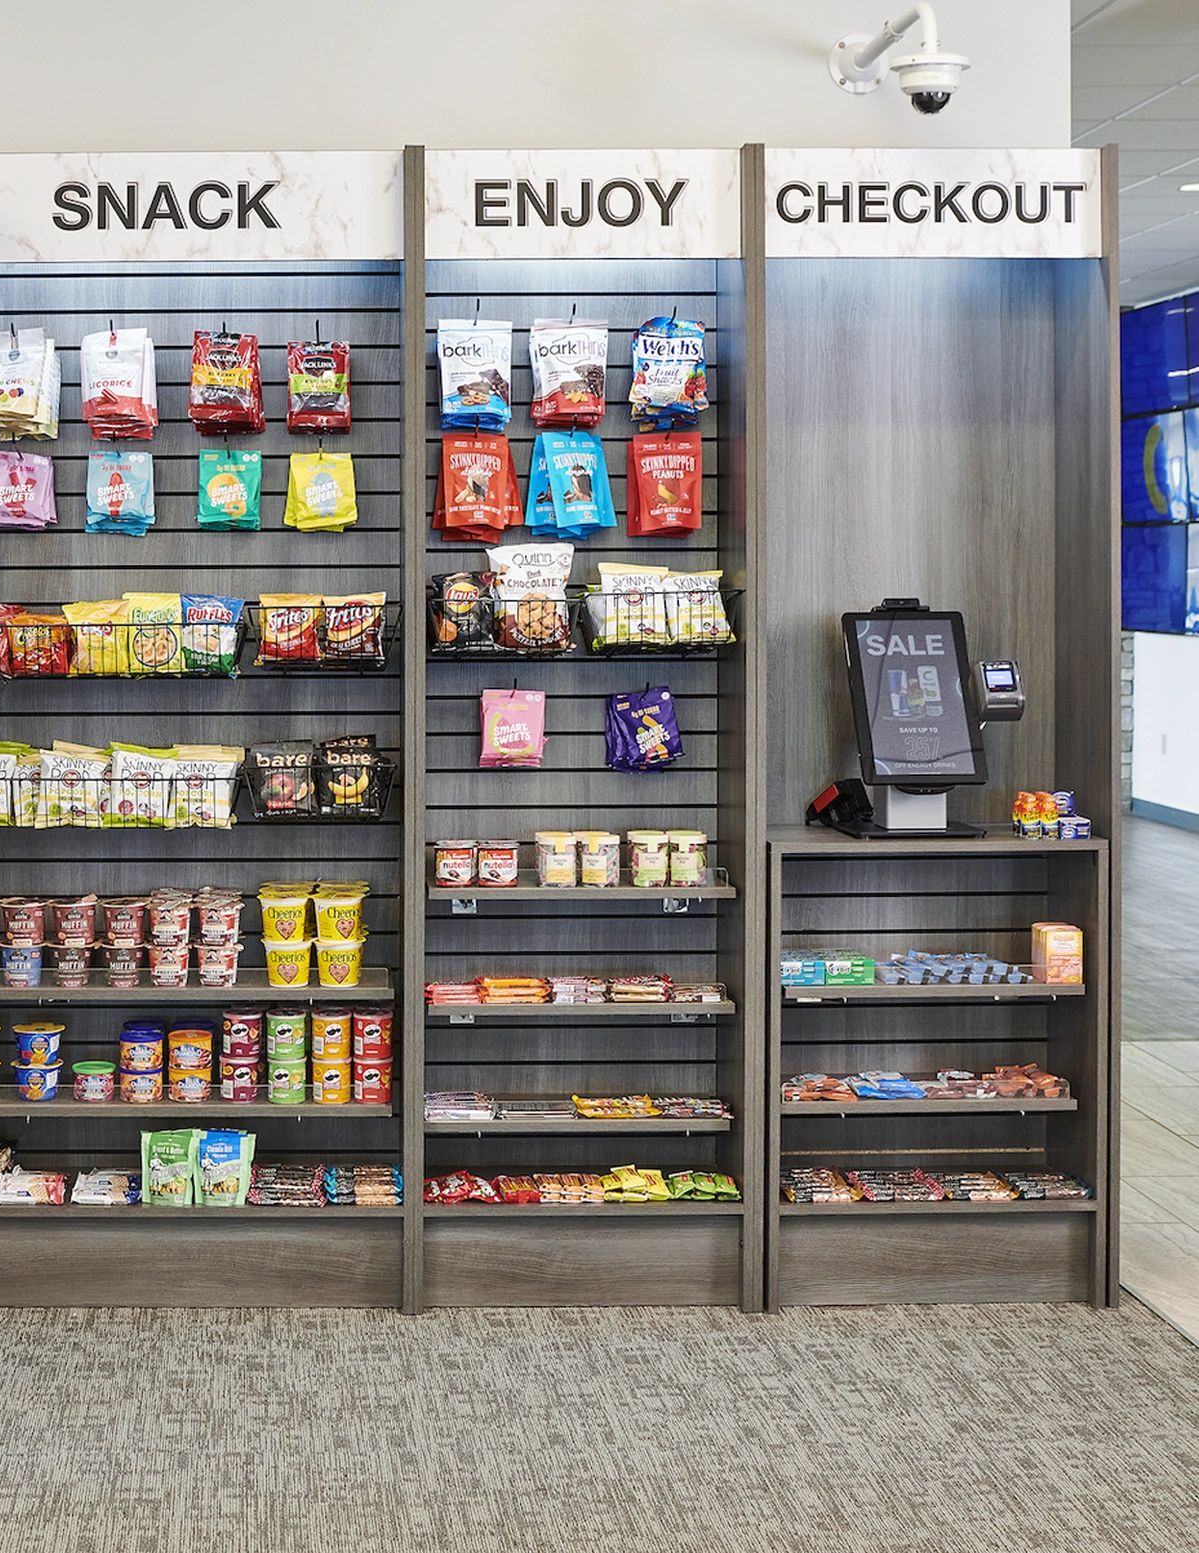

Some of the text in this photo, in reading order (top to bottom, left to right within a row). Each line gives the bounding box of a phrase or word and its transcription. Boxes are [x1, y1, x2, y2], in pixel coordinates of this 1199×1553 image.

[52, 180, 280, 230] SNACK
[475, 177, 688, 228] ENJOY
[776, 182, 1087, 223] CHECKOUT
[641, 337, 700, 357] Welch's
[89, 379, 133, 390] LICORICE
[652, 470, 684, 480] PEANUTS
[97, 483, 132, 496] SMART
[211, 484, 246, 498] SMART
[96, 492, 135, 507] SWEETS
[210, 491, 249, 507] SWEETS
[507, 577, 558, 589] CHOCOLATE
[611, 575, 656, 588] SKINNY
[187, 607, 233, 622] RUFFLES
[268, 607, 309, 630] Fritos
[325, 605, 373, 626] Fritos
[865, 634, 945, 657] SALE
[493, 723, 529, 735] SMART
[492, 732, 532, 747] SWEETS
[904, 736, 944, 761] 25%
[52, 756, 95, 770] SKINNY
[123, 757, 165, 771] SKINNY
[256, 752, 308, 767] bare
[327, 750, 372, 765] bare
[176, 763, 217, 773] SKINNY
[443, 861, 471, 870] nutella
[484, 860, 513, 870] nutella
[268, 907, 303, 919] Cheerios
[8, 920, 36, 930] MUFFIN
[61, 920, 88, 929] MUFFIN
[111, 920, 138, 930] MUFFIN
[270, 951, 306, 963] Cheerios
[321, 951, 357, 964] Cheerios
[6, 961, 32, 970] MUFFIN
[58, 961, 86, 970] MUFFIN
[110, 961, 137, 970] MUFFIN
